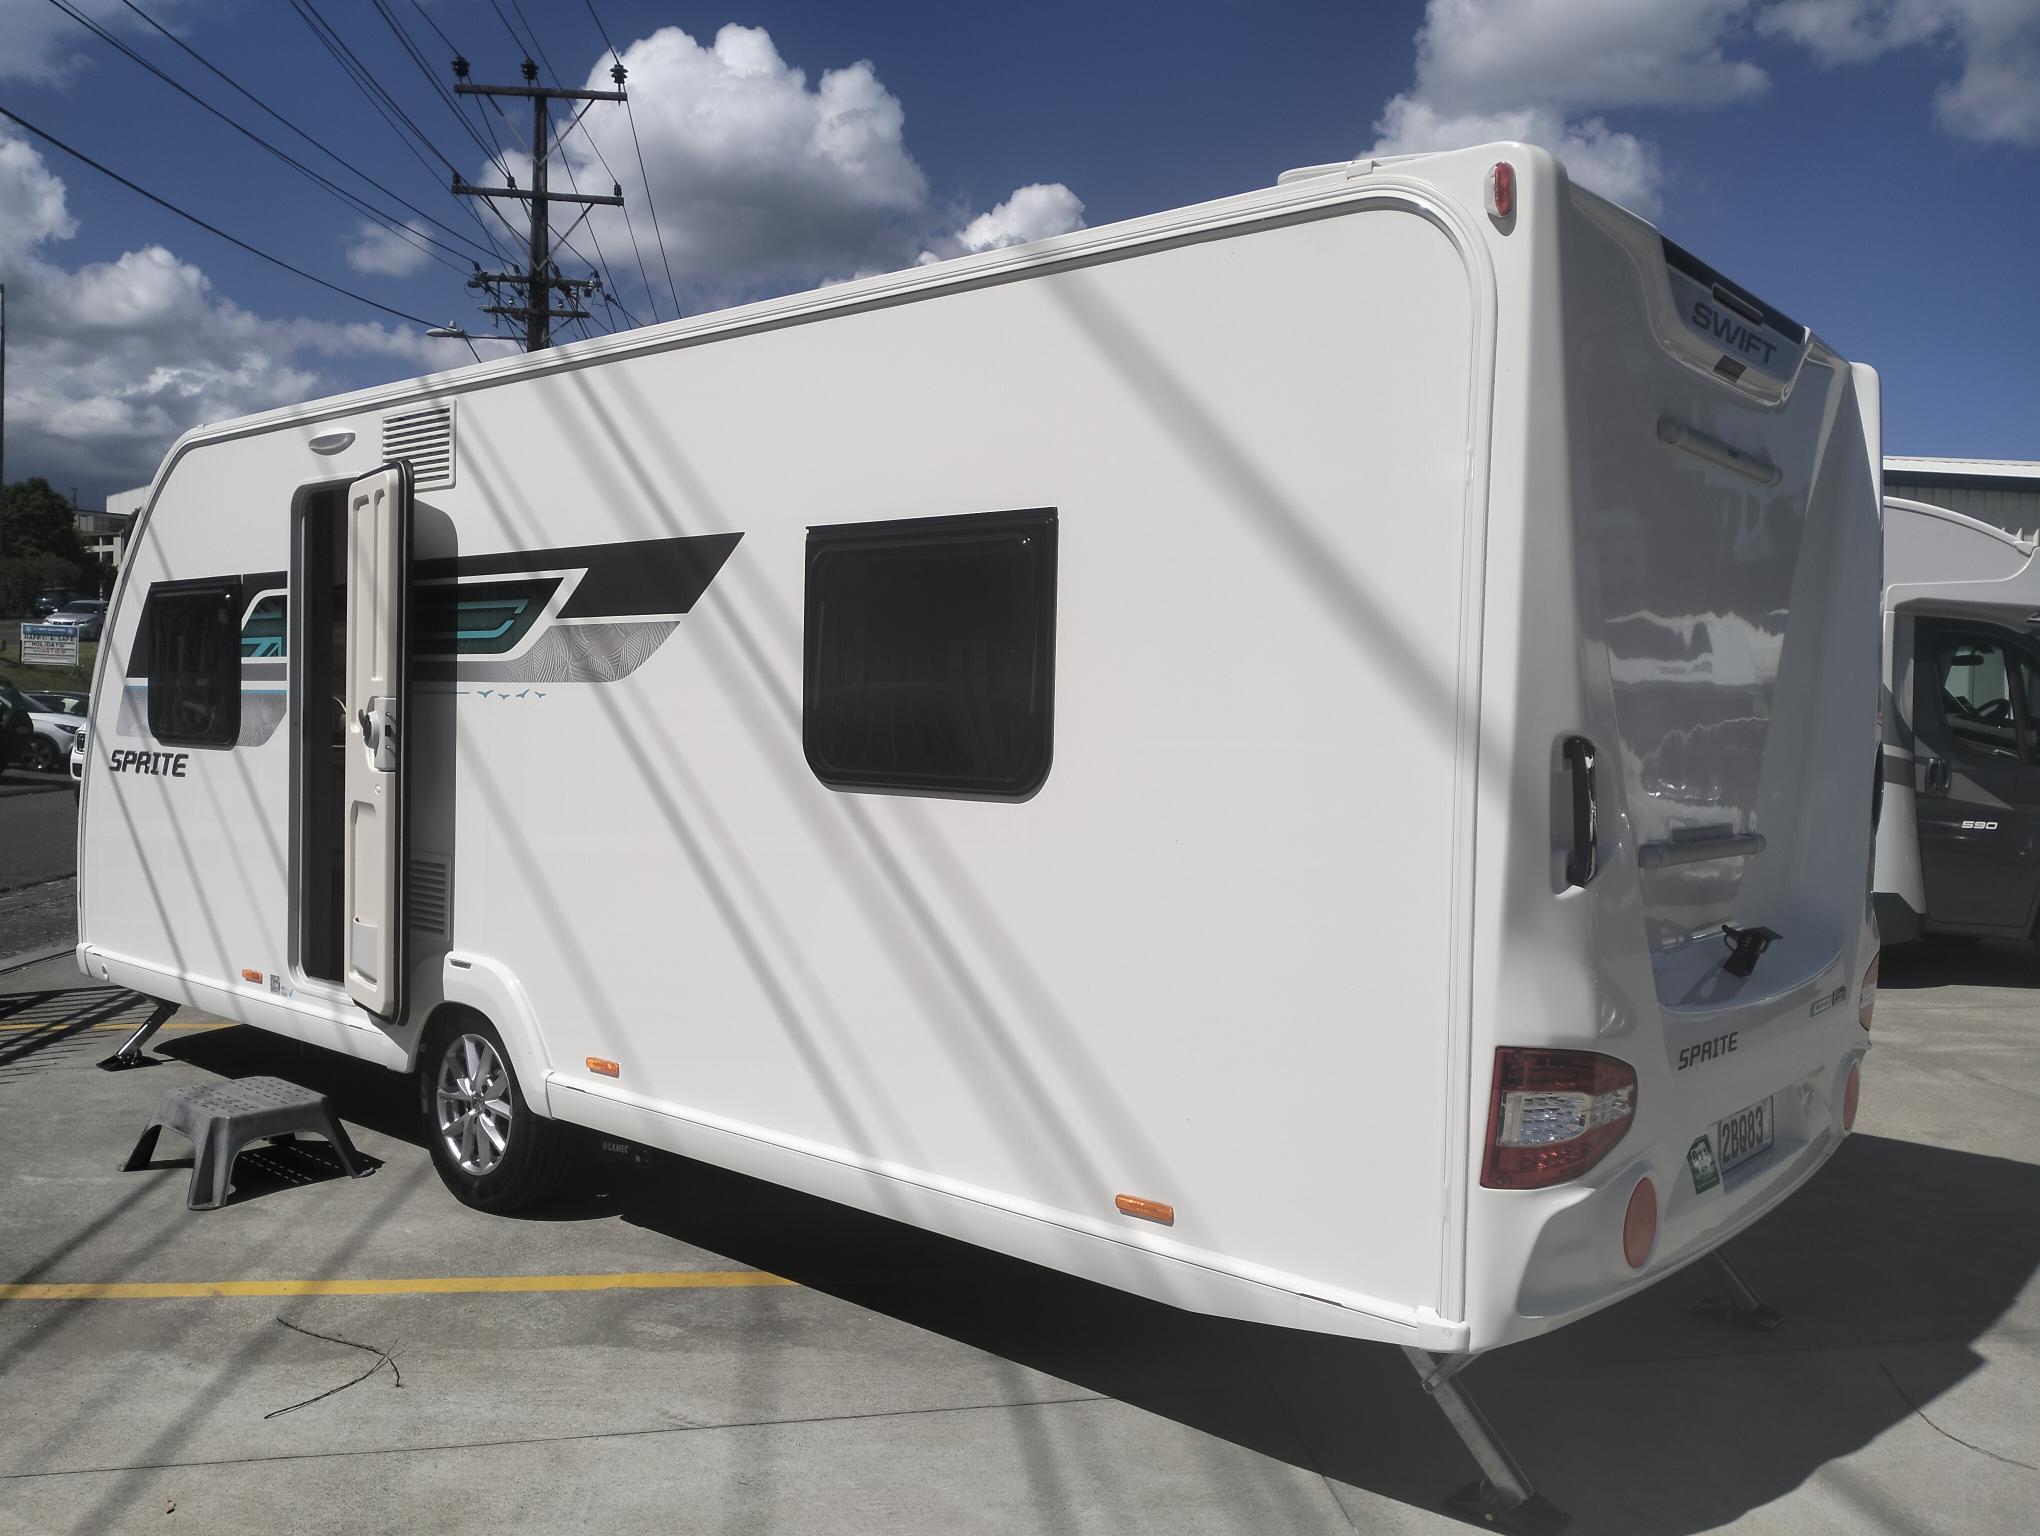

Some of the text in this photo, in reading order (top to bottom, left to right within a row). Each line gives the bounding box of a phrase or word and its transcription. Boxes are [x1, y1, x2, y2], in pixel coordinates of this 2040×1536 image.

[1692, 302, 1777, 364] SWIFT
[109, 749, 189, 778] SPRITE
[1961, 820, 1998, 830] 590
[1678, 1031, 1738, 1071] SPRITE
